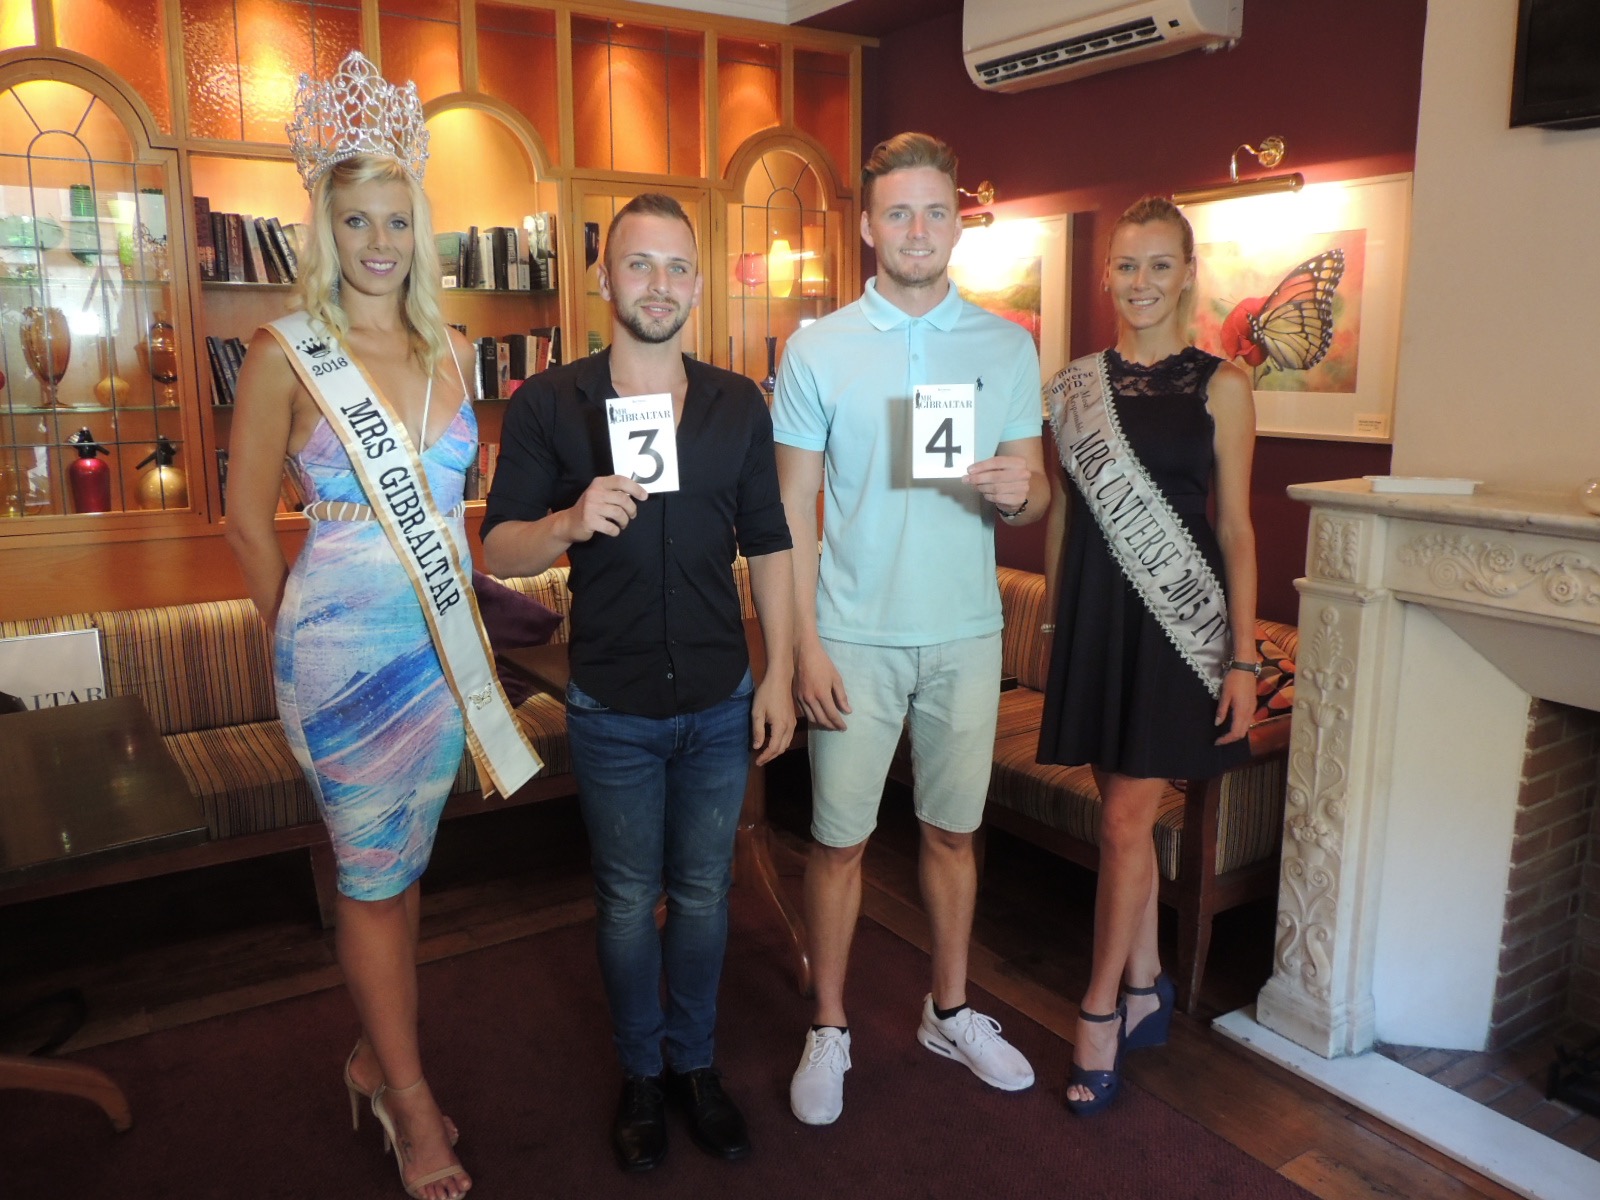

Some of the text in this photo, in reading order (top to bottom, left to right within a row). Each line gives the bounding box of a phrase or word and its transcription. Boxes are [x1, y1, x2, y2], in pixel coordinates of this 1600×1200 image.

[311, 357, 349, 377] 2016
[1051, 371, 1094, 395] universe
[919, 400, 973, 409] GIBRALTAR
[628, 428, 665, 484] 3
[925, 417, 962, 468] 4
[340, 397, 460, 616] MRS GIBRALTAR
[1069, 429, 1117, 487] MRS.
[1096, 472, 1183, 578] UNIVERSE
[1159, 568, 1211, 621] 2015
